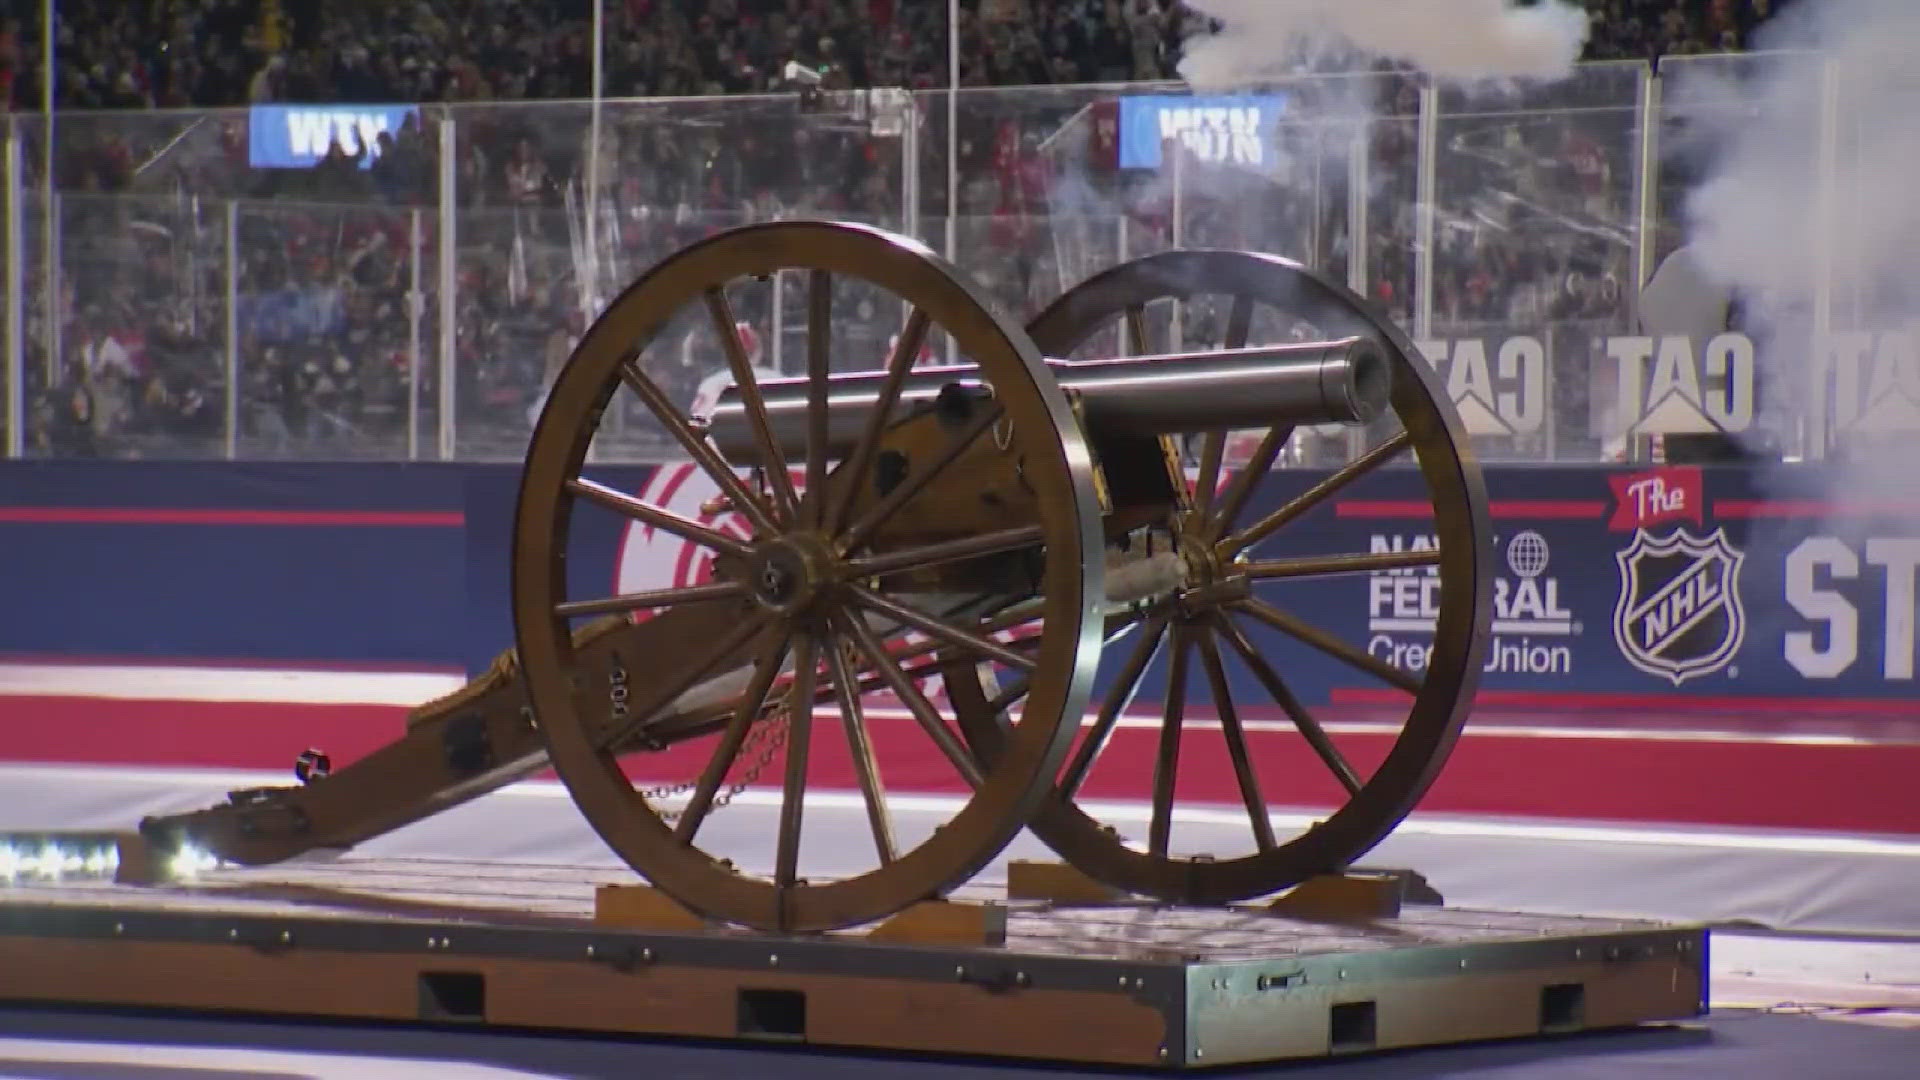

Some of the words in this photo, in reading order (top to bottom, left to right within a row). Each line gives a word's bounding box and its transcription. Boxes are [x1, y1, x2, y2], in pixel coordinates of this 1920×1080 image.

[1627, 477, 1686, 521] The
[1370, 576, 1571, 619] FEDRAL
[1644, 564, 1719, 649] NHL
